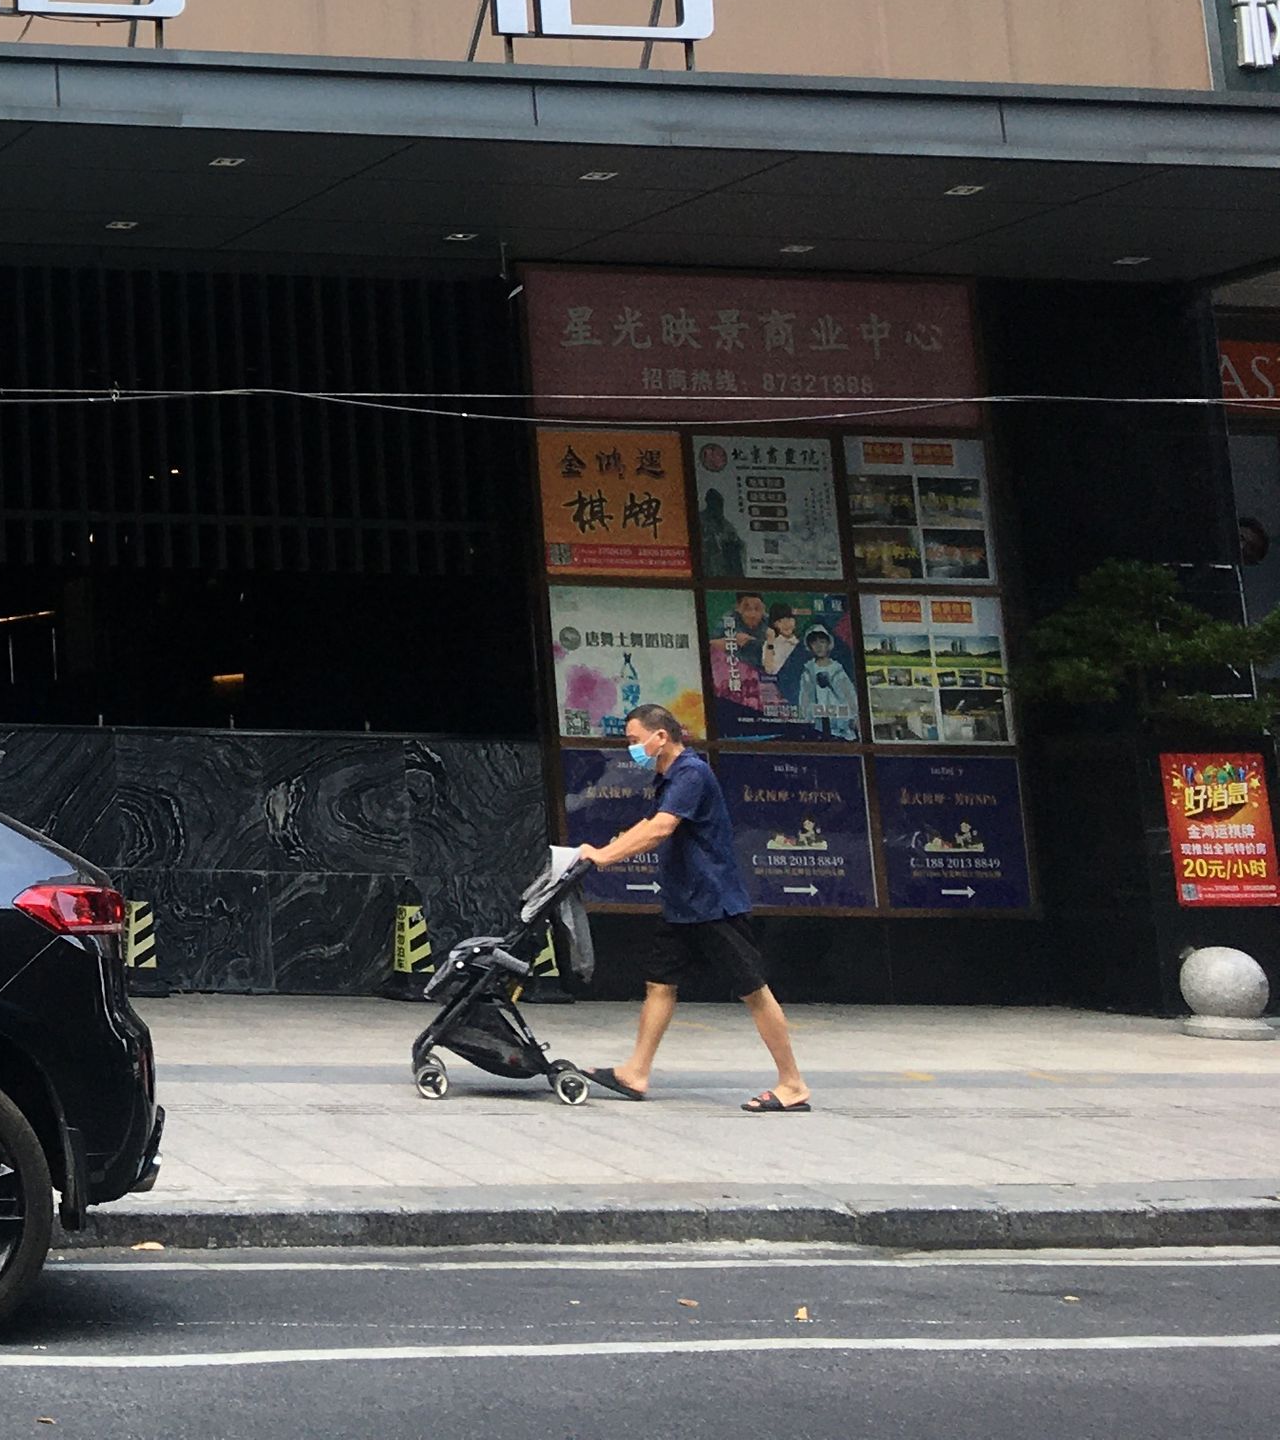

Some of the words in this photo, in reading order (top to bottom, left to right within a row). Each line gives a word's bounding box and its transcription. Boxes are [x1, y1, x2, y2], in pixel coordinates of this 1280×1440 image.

[559, 305, 943, 359] 星光映景商业中心
[1184, 782, 1250, 817] 好消息
[1187, 824, 1256, 839] 金鸿运棋牌
[1183, 858, 1267, 880] 20元/小时
